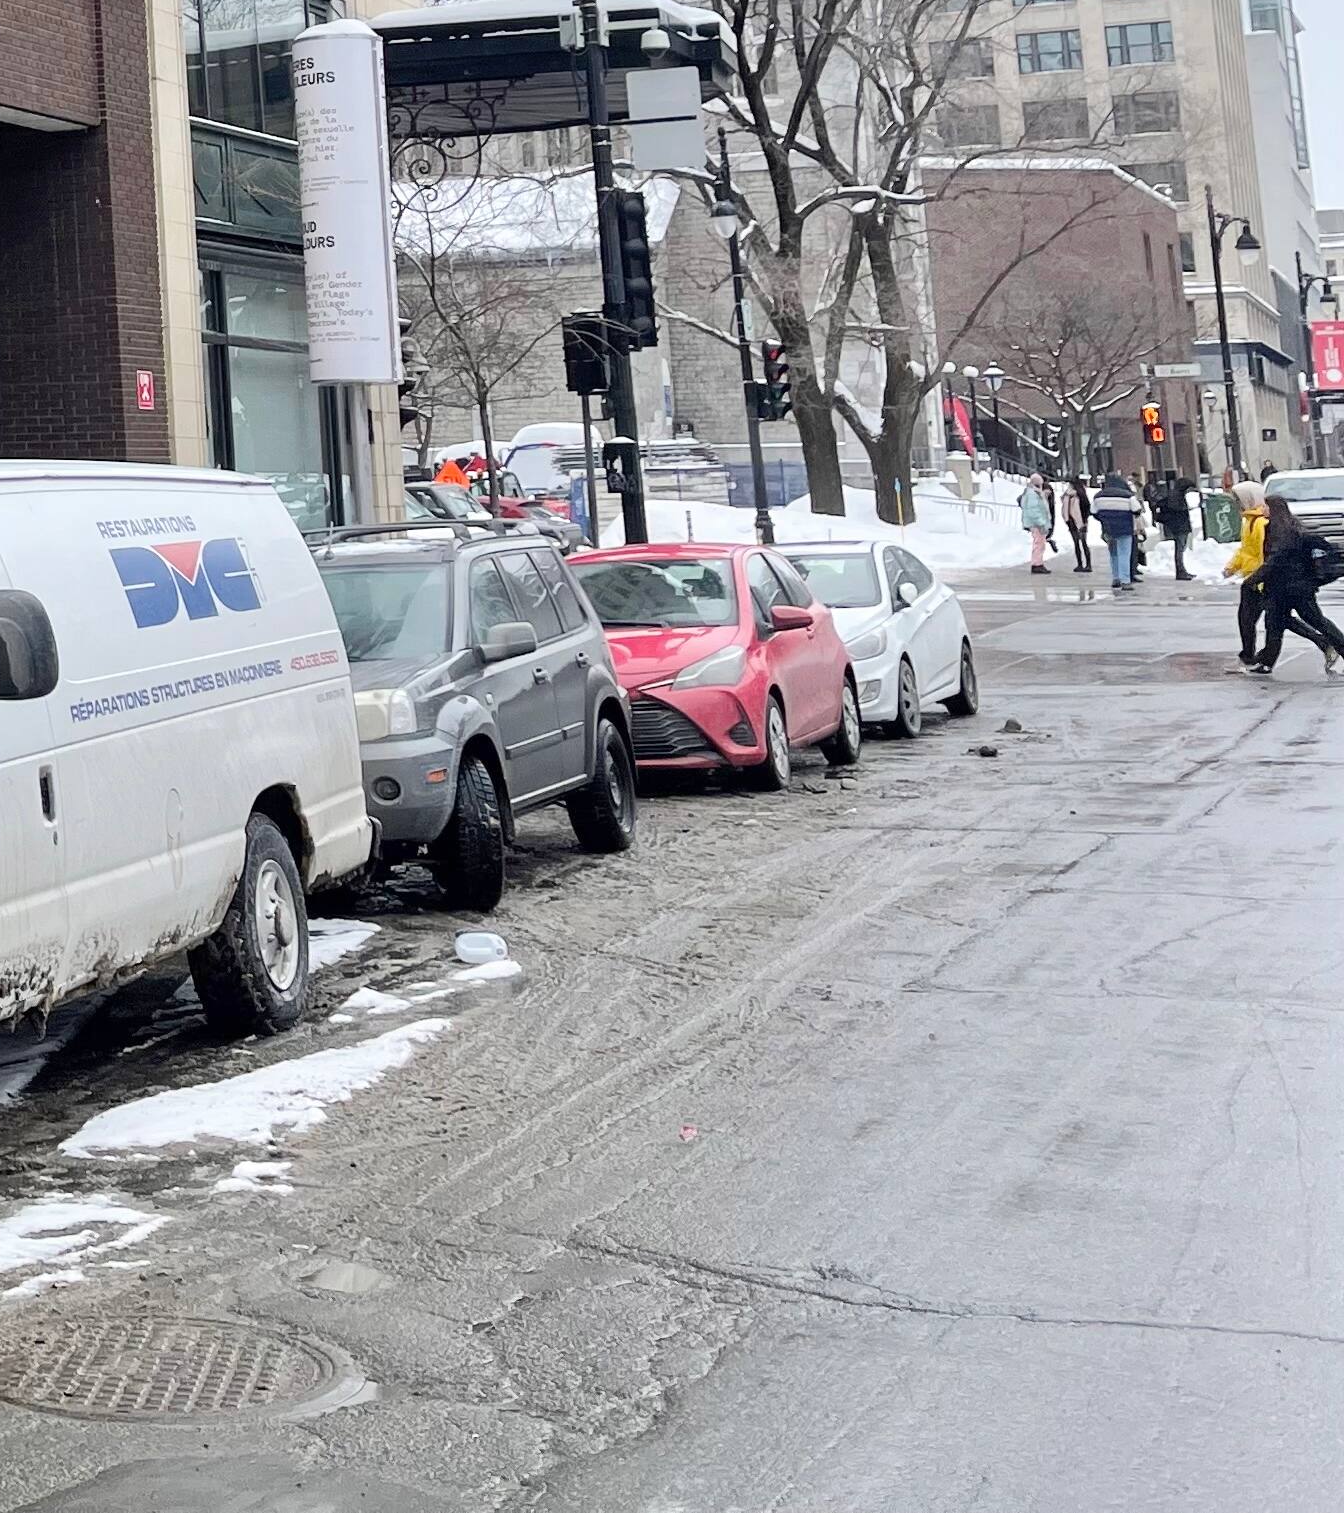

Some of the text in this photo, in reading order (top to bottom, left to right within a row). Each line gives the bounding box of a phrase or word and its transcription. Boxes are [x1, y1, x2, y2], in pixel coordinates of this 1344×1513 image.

[96, 515, 197, 539] RESTAURATIONS
[70, 688, 151, 723] RÉPARATIONS
[152, 674, 215, 704] STRUCTURES
[215, 671, 230, 689] EN
